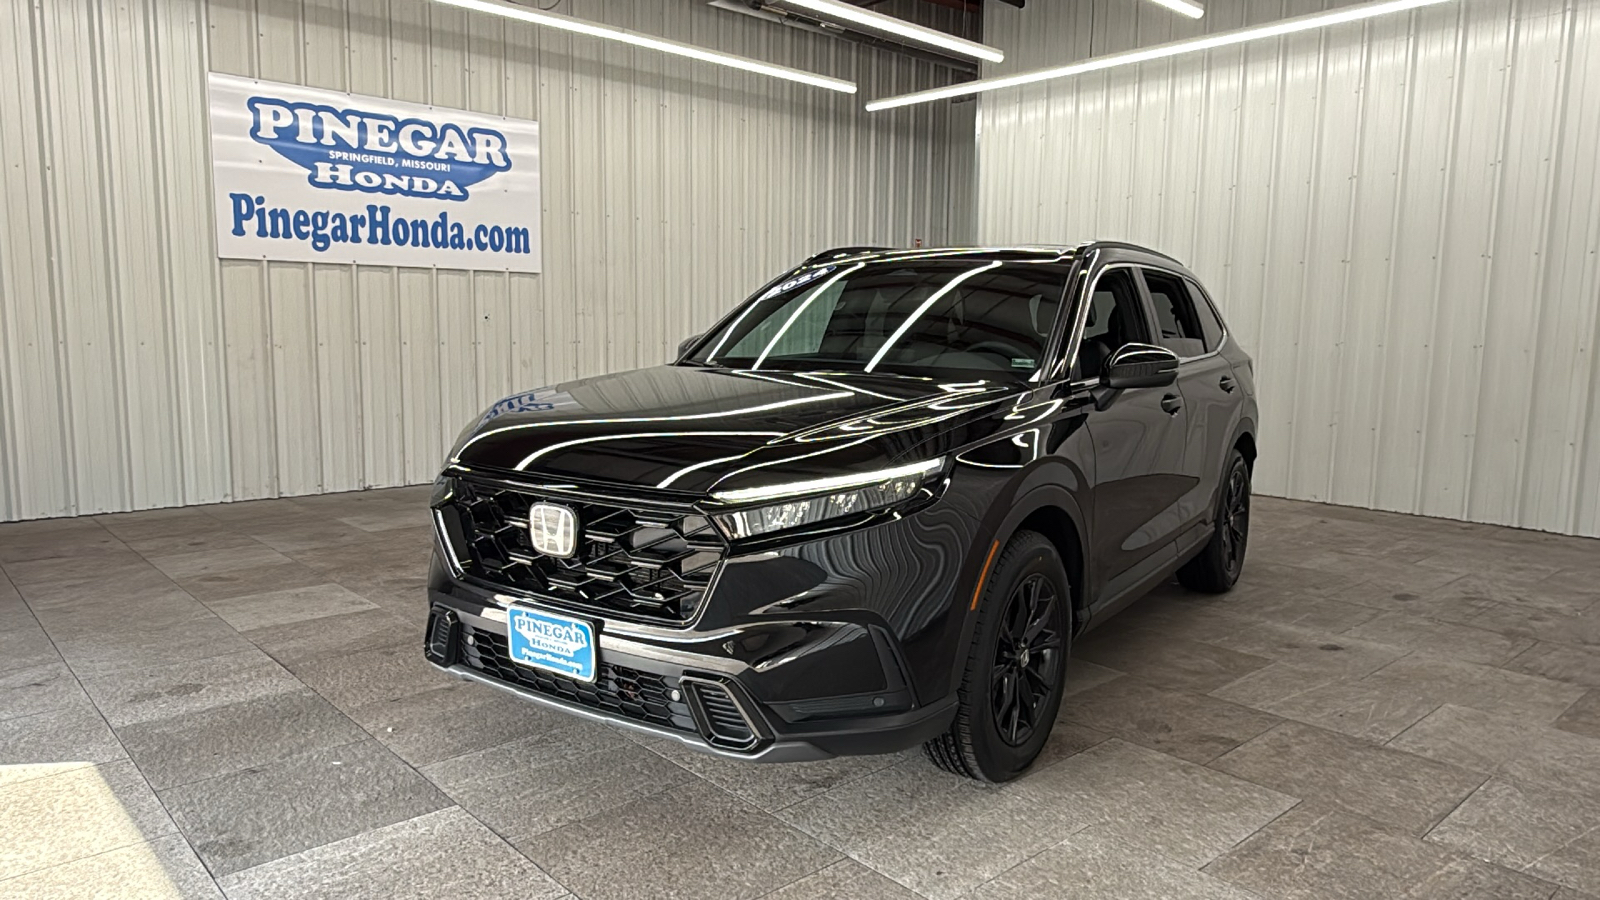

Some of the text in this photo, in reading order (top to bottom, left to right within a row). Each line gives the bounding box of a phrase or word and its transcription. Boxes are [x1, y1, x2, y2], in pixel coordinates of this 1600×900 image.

[253, 102, 508, 168] PINEGAR
[329, 150, 451, 173] SPRINGFIELD, MISSOURI
[312, 161, 465, 197] HONDA
[229, 192, 531, 254] PinegarHonda.com
[517, 618, 585, 645] PINEGAR
[531, 637, 572, 654] HONDA
